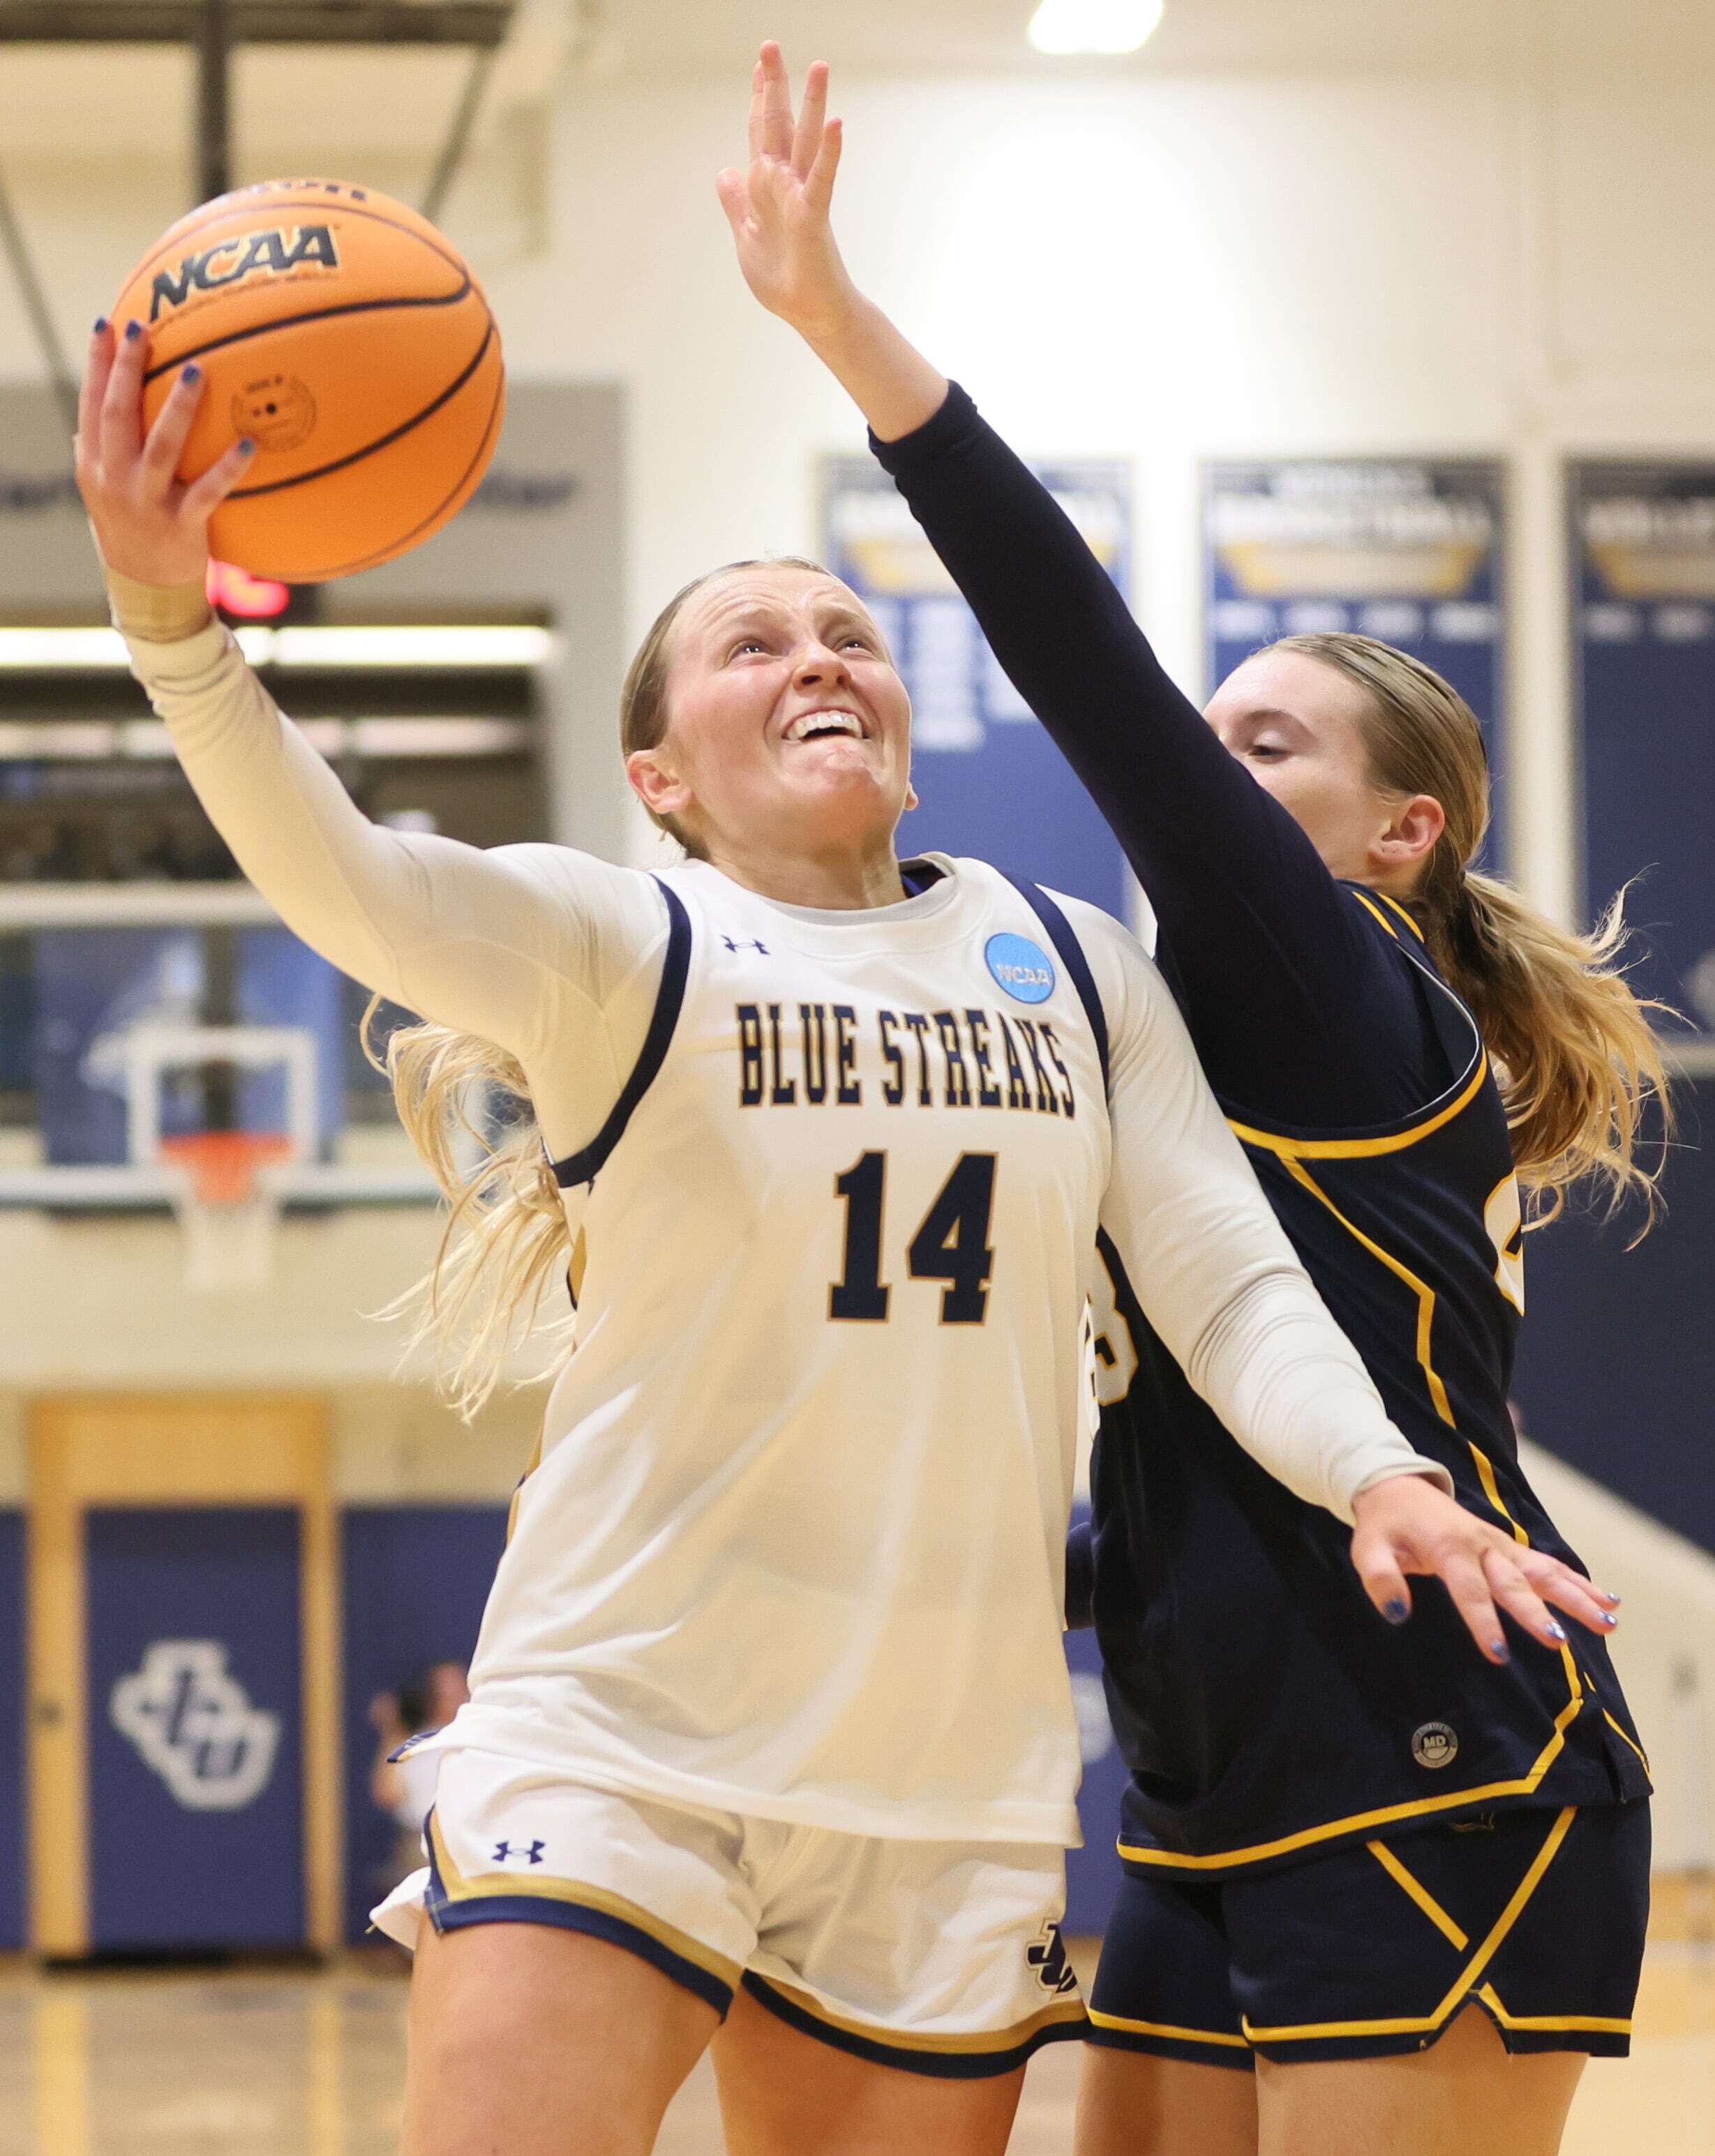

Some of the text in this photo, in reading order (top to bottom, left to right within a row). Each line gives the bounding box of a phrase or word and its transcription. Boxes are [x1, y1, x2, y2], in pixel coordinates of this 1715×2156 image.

[149, 224, 339, 323] NCAA
[996, 964, 1051, 986] NCAA
[735, 1002, 1075, 1121] BLUE STREAKS
[827, 1148, 999, 1326] 14
[1423, 1735, 1446, 1748] MD
